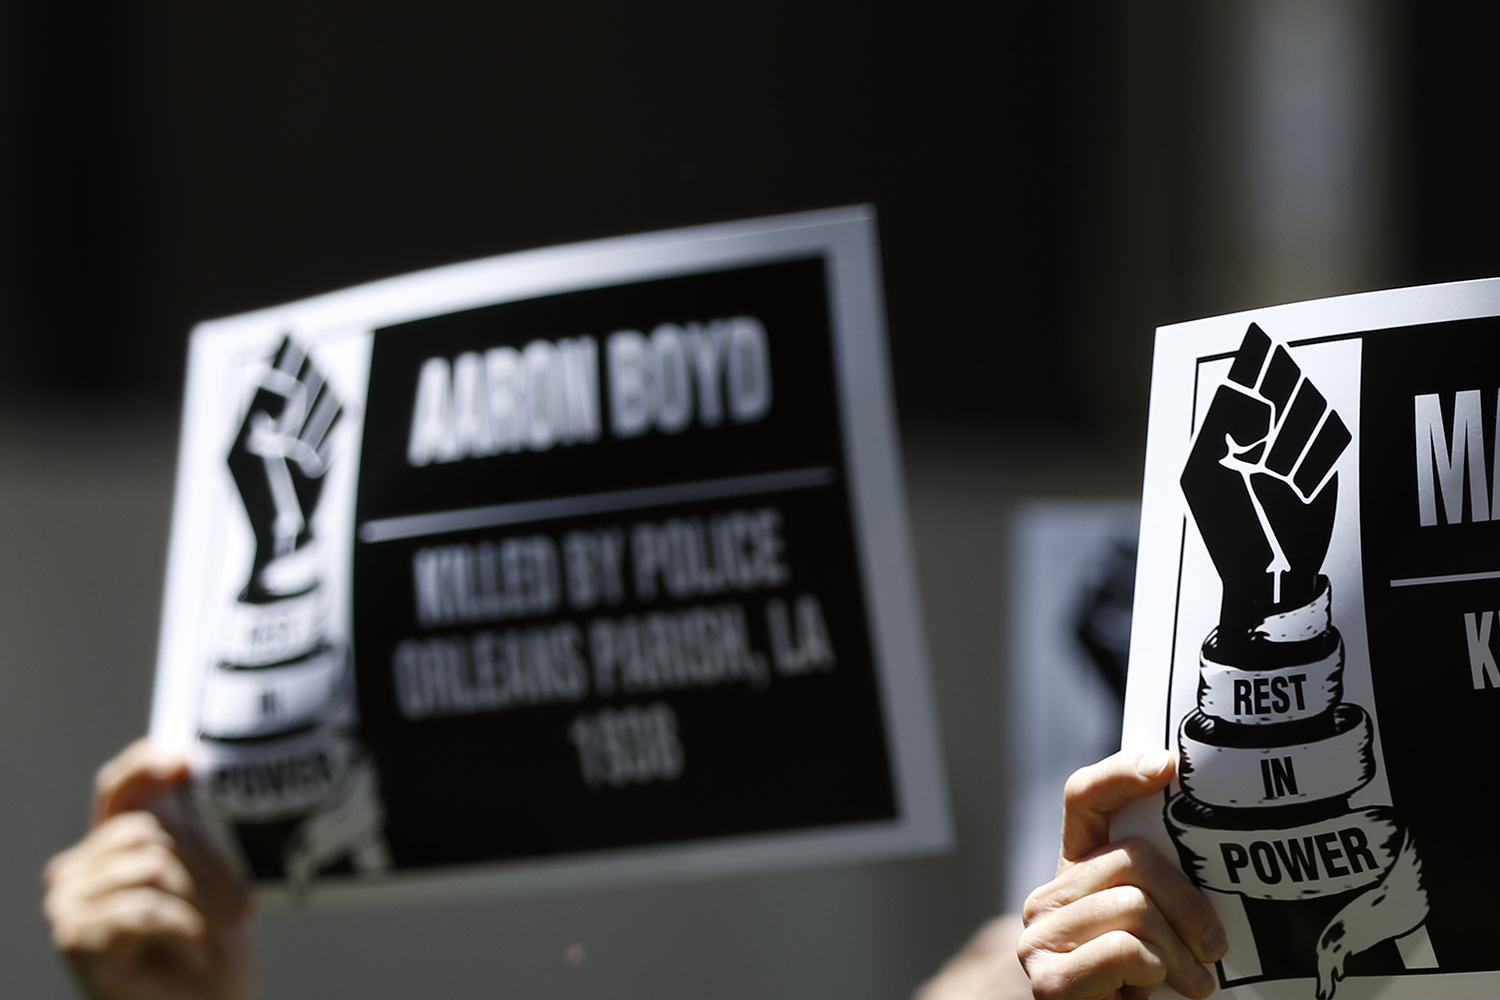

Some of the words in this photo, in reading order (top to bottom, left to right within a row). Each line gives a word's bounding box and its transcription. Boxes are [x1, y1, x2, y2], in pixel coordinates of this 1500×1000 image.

[407, 335, 601, 467] AARON
[605, 315, 773, 439] BOYD
[413, 535, 560, 628] KILLED
[563, 526, 626, 610] BY
[630, 507, 791, 603] POLICE
[393, 621, 589, 720] ORLEANS
[766, 592, 836, 676] LA
[1233, 673, 1307, 715] REST
[1260, 756, 1299, 799] IN
[1219, 827, 1380, 885] POWER
